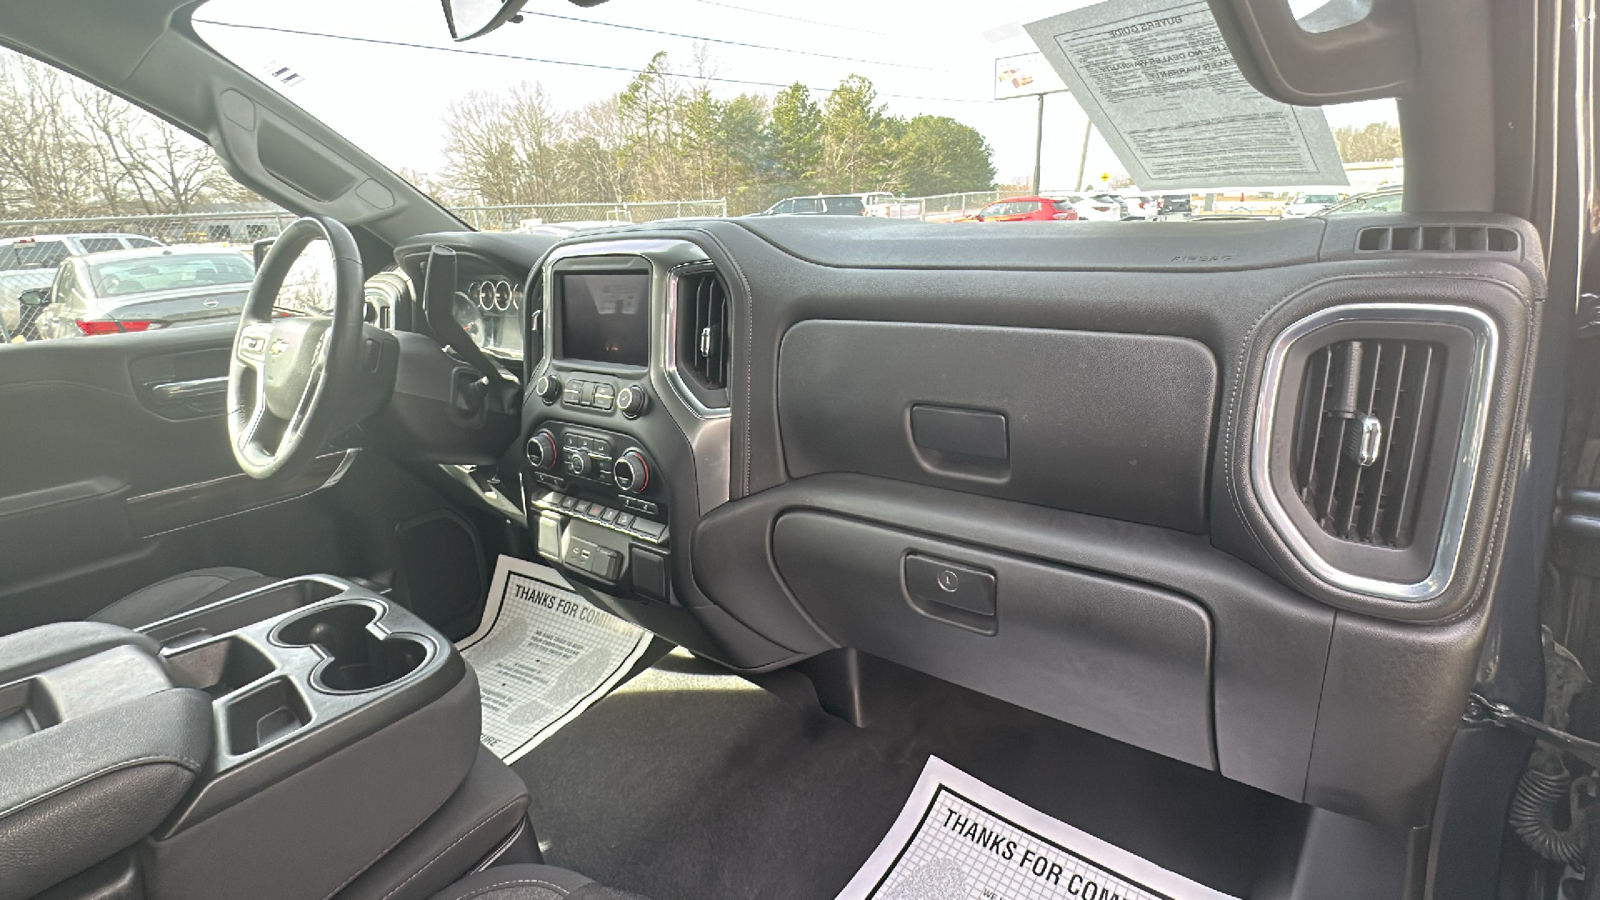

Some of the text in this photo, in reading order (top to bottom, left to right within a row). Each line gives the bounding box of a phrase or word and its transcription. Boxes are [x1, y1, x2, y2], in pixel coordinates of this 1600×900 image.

[515, 584, 556, 609] THANKS
[556, 599, 579, 617] FOR
[943, 808, 1127, 900] THANKS FOR COM
